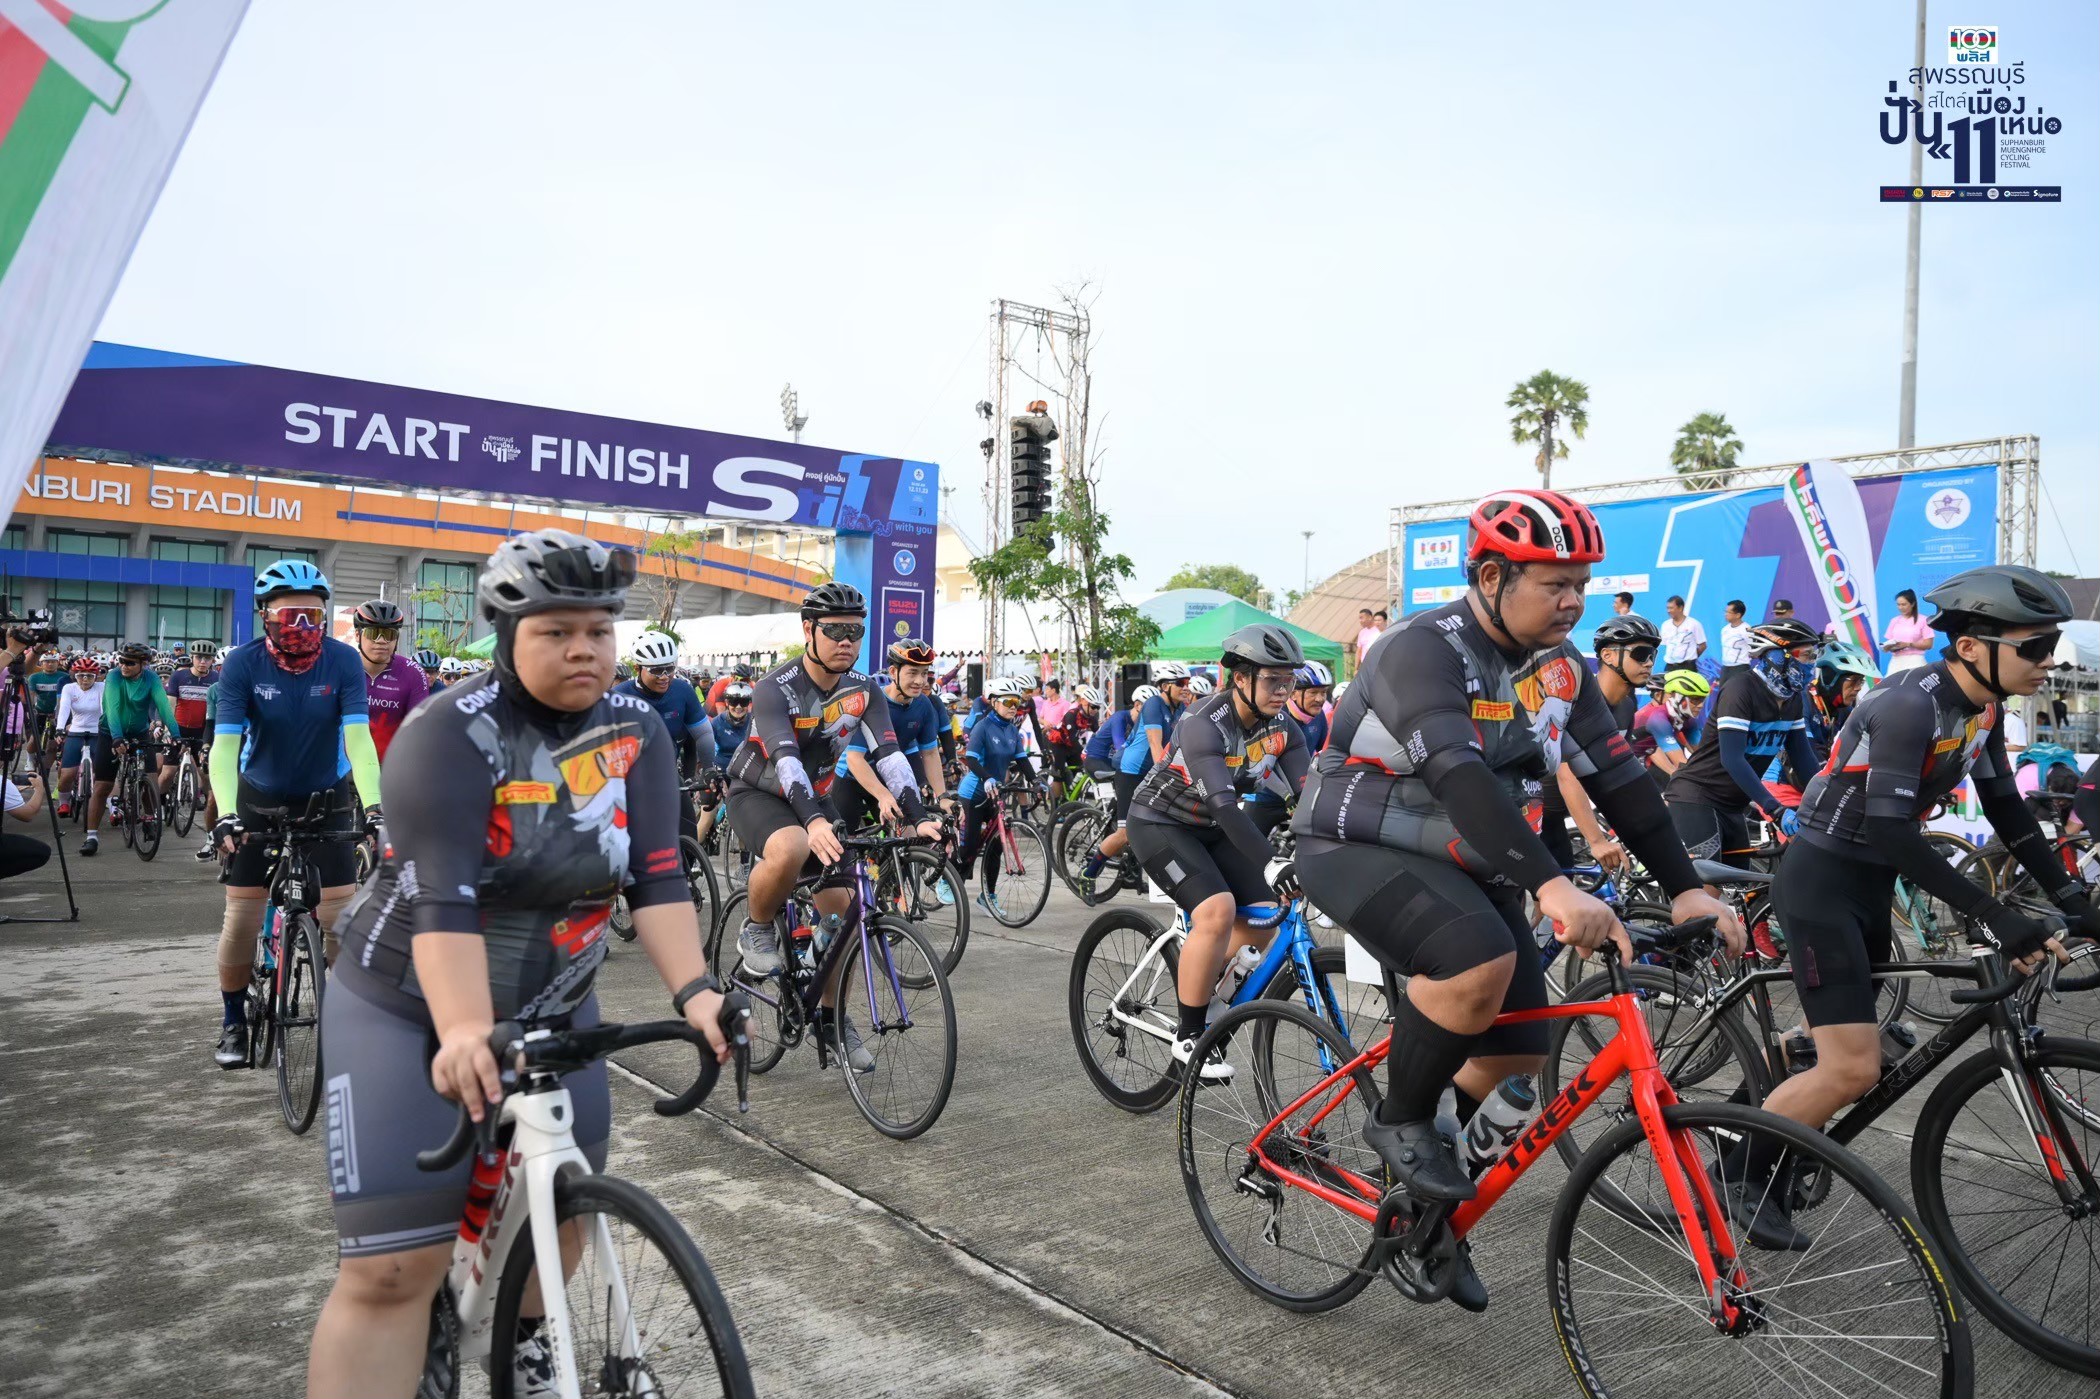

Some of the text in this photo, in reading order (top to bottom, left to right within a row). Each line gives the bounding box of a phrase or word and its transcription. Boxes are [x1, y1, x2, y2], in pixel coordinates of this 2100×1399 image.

[284, 402, 471, 462] START
[531, 434, 690, 490] FINISH
[150, 485, 302, 522] STADIUM
[895, 522, 914, 533] with
[916, 525, 933, 536] you
[1552, 526, 1564, 552] POC
[1420, 539, 1453, 556] 100
[1424, 557, 1449, 568] พลัส
[1820, 547, 1870, 624] 100
[888, 599, 918, 609] ISUZU
[775, 665, 867, 685] COMP OTO
[1918, 672, 1941, 693] COMP
[602, 691, 651, 714] OTO
[1209, 702, 1229, 723] COMP
[1406, 739, 1418, 764] SPEED
[1862, 1034, 1951, 1112] TREK
[1497, 1067, 1598, 1172] TREK
[327, 1073, 361, 1194] PIRELLI
